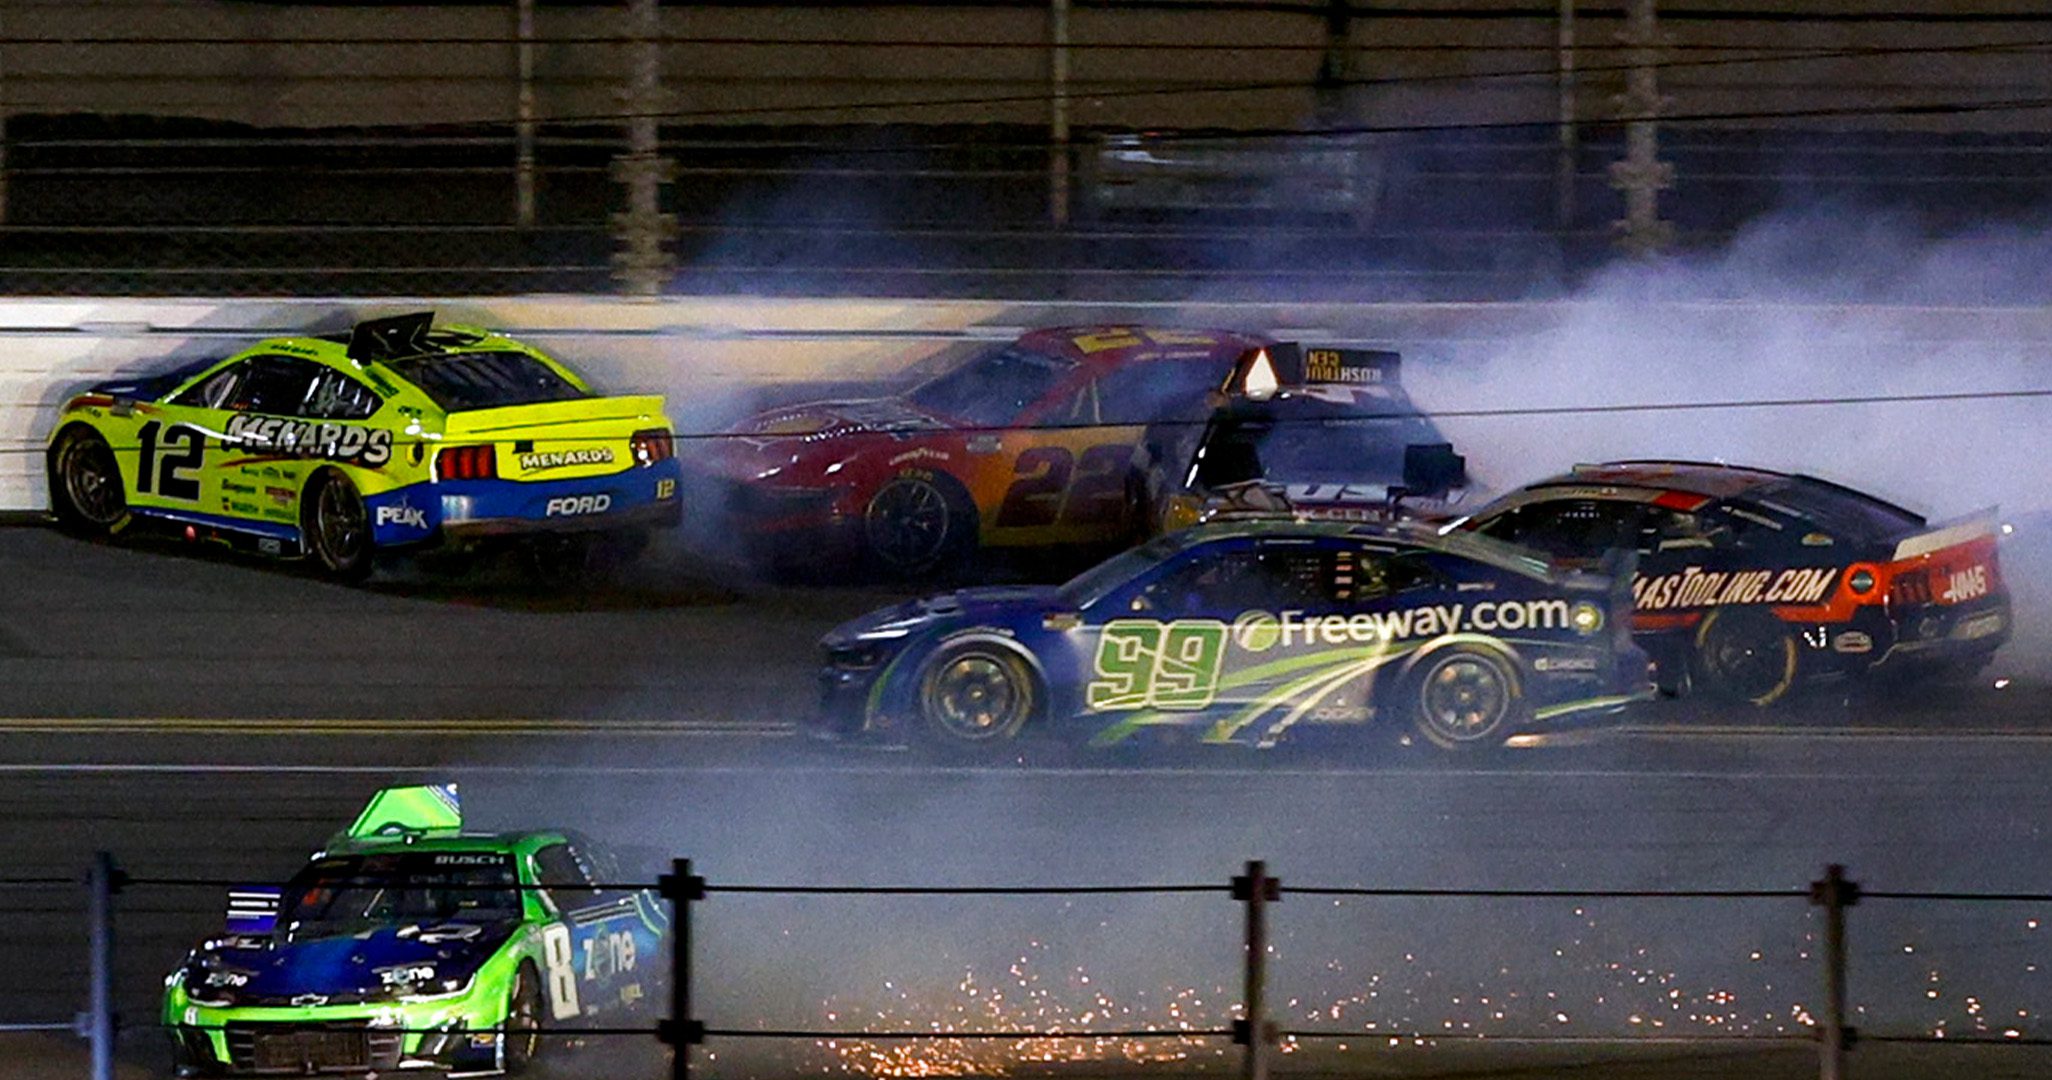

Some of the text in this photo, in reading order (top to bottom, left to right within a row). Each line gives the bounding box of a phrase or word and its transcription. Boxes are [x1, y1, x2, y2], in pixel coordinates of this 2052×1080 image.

[221, 414, 393, 469] MENARDS
[136, 419, 206, 502] 12
[520, 448, 616, 471] MENARDS
[656, 479, 676, 499] 12
[996, 444, 1138, 528] 22
[376, 505, 428, 530] PEAK
[546, 494, 612, 517] FORD
[1087, 599, 1569, 712] 99 Freeway.com
[435, 855, 505, 865] BUSCH
[381, 966, 436, 985] zone
[542, 922, 581, 1021] 8
